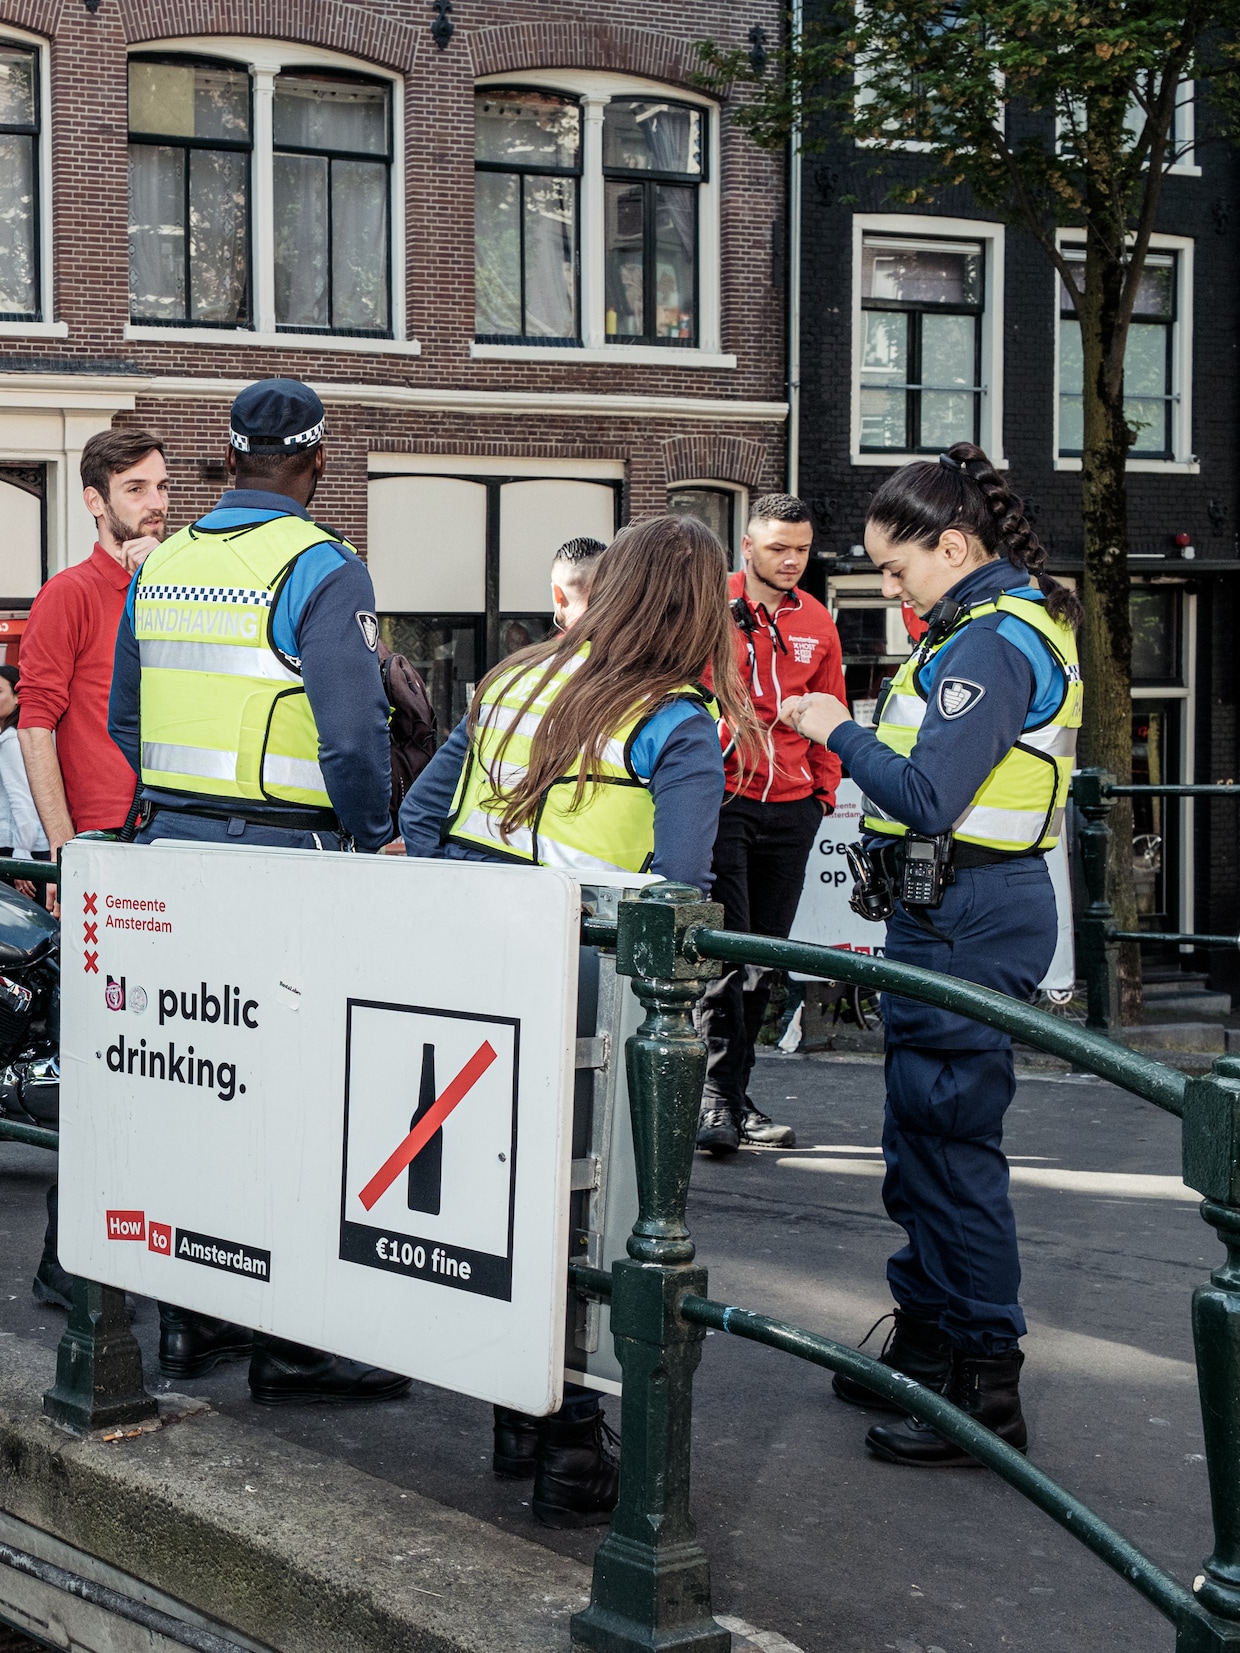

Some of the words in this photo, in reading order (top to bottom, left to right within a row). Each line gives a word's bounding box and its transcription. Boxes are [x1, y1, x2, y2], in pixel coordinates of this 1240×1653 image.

[137, 607, 257, 639] HANDHAVING
[819, 839, 847, 855] Ge
[820, 871, 847, 887] op
[105, 894, 167, 913] Gemeente
[105, 914, 173, 934] Amsterdam
[158, 981, 260, 1030] public
[106, 1034, 247, 1101] drinking.
[110, 1217, 142, 1236] How
[151, 1229, 168, 1249] to
[178, 1236, 268, 1276] Amsterdam
[375, 1236, 426, 1269] €100
[431, 1247, 472, 1280] fine
